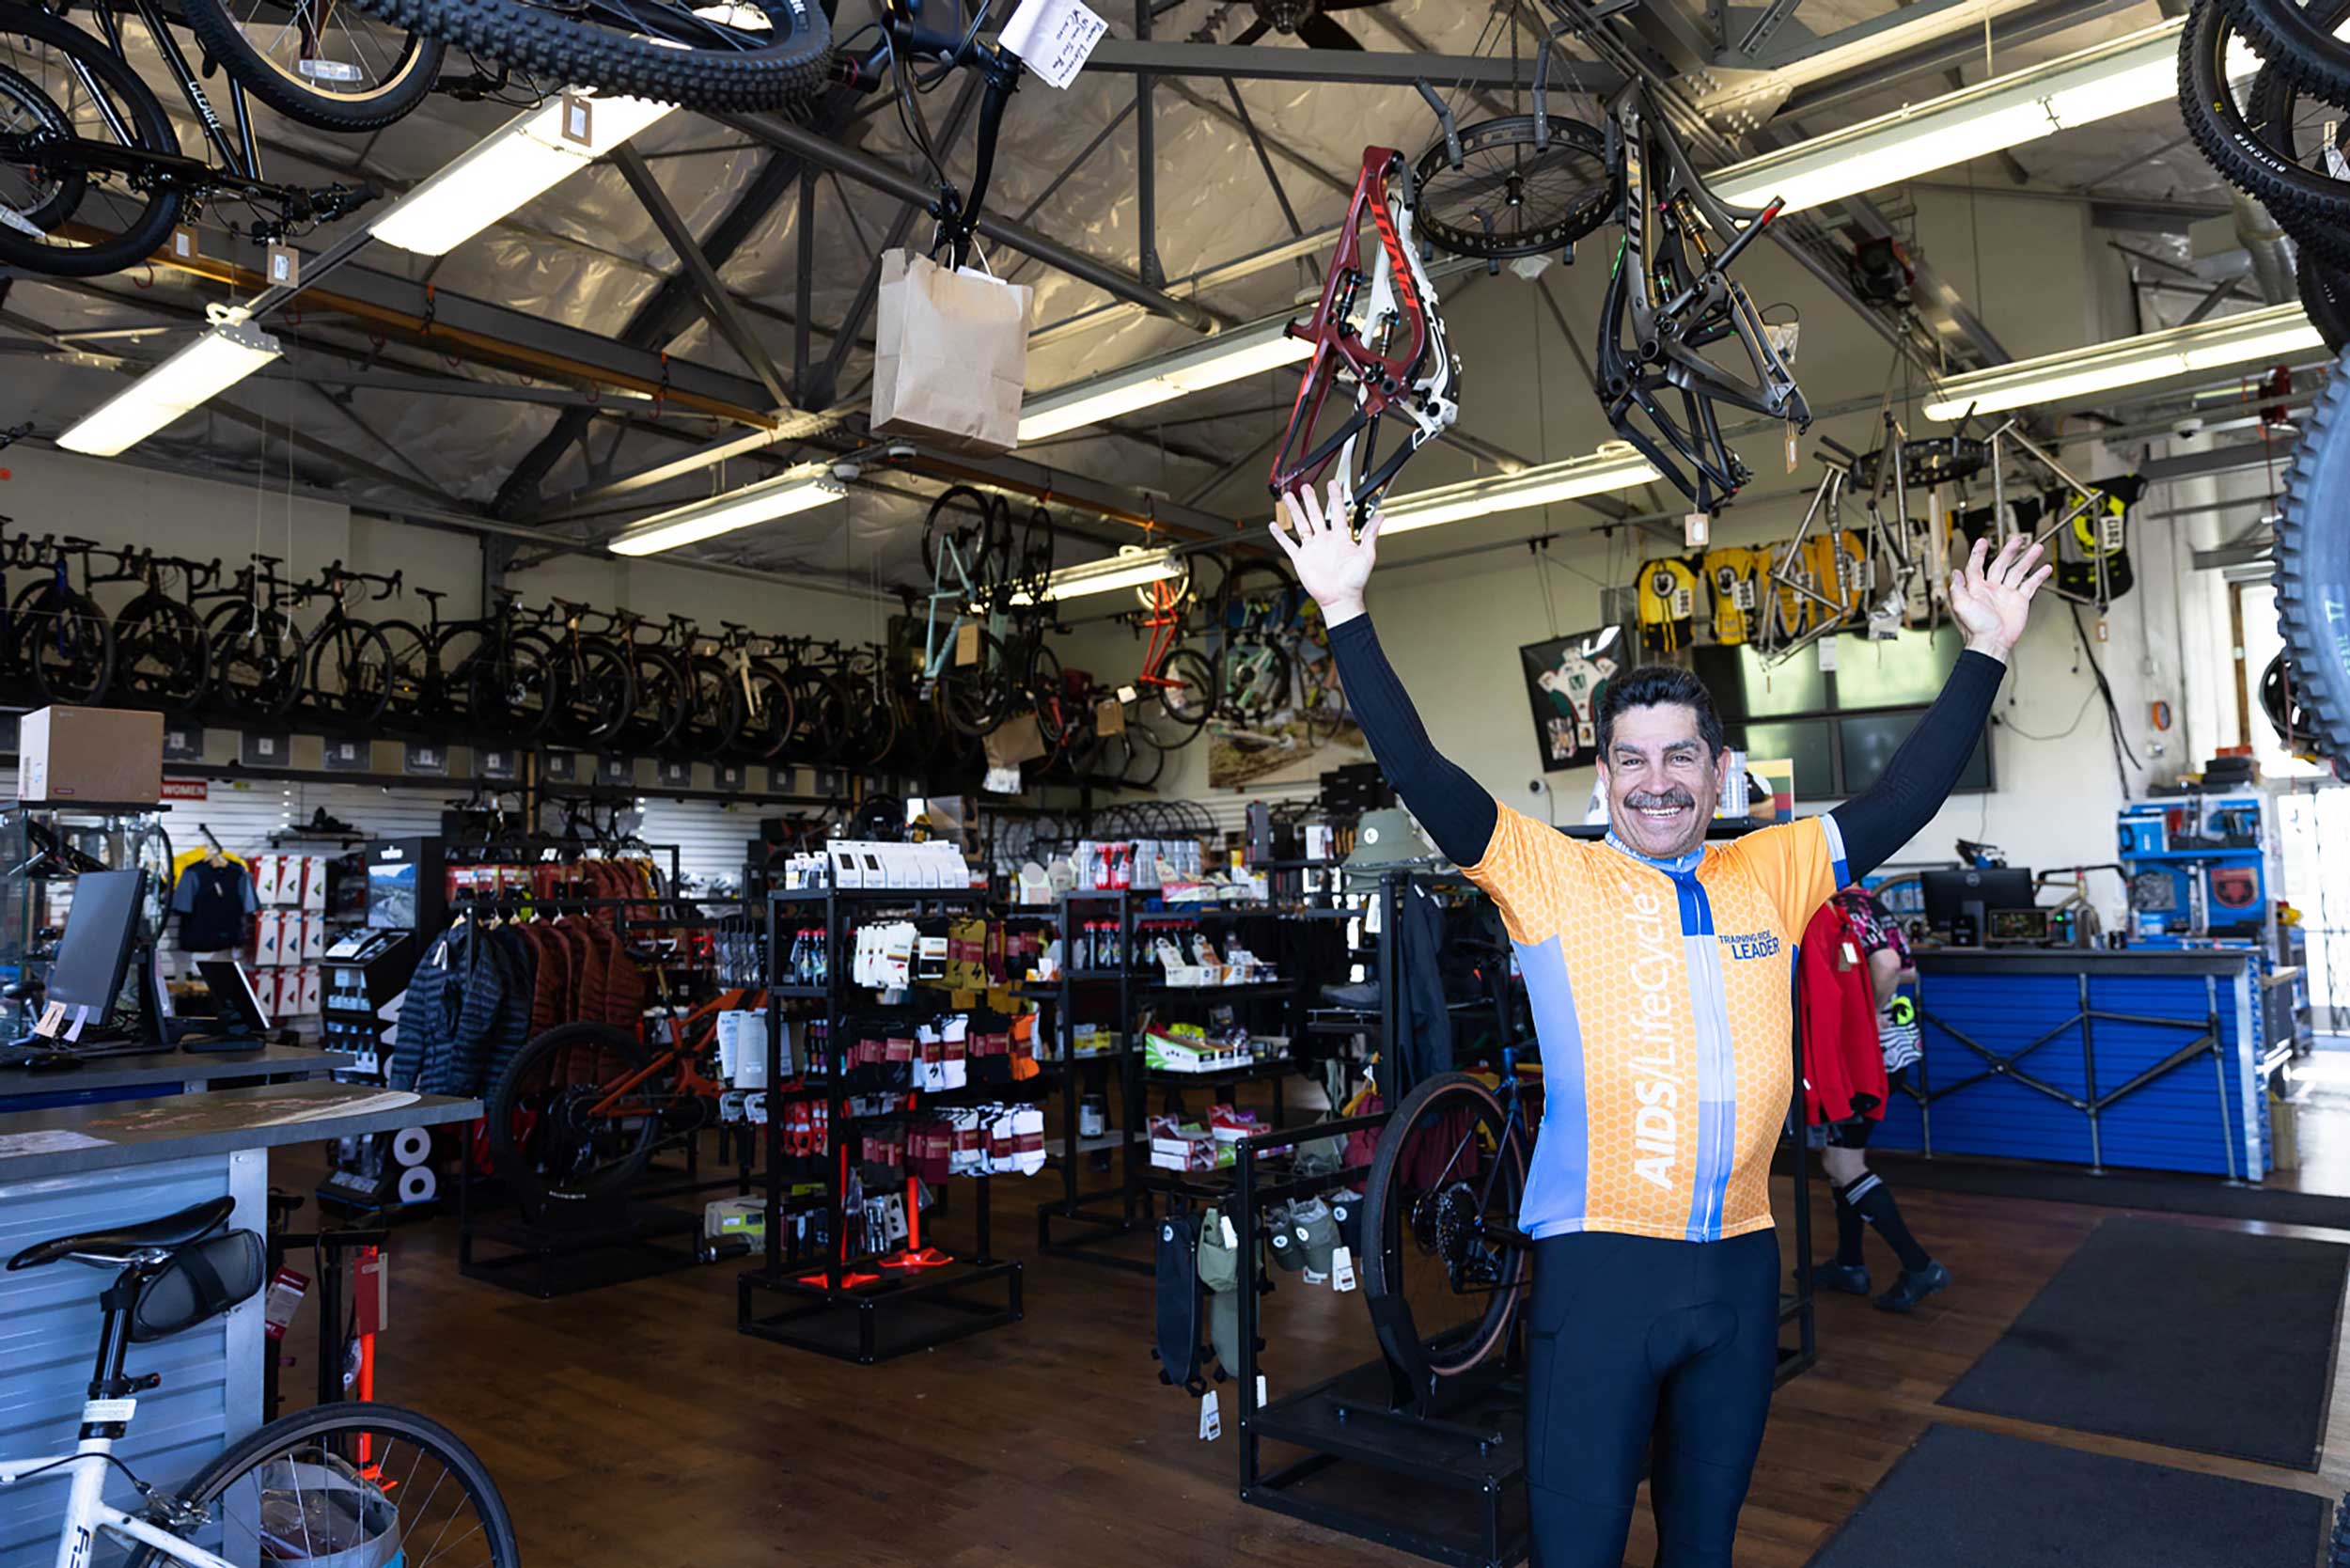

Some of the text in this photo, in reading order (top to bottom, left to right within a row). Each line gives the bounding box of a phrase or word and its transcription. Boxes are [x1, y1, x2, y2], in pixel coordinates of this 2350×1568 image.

[188, 81, 223, 130] CLEARY
[2233, 132, 2287, 174] BUTCHER
[1367, 192, 1418, 311] PIVOT
[163, 784, 206, 796] WOMEN
[1718, 929, 1772, 945] TRAINING RIDE
[1731, 936, 1781, 961] LEADER
[1628, 891, 1685, 1191] AIDS/LifeCycle
